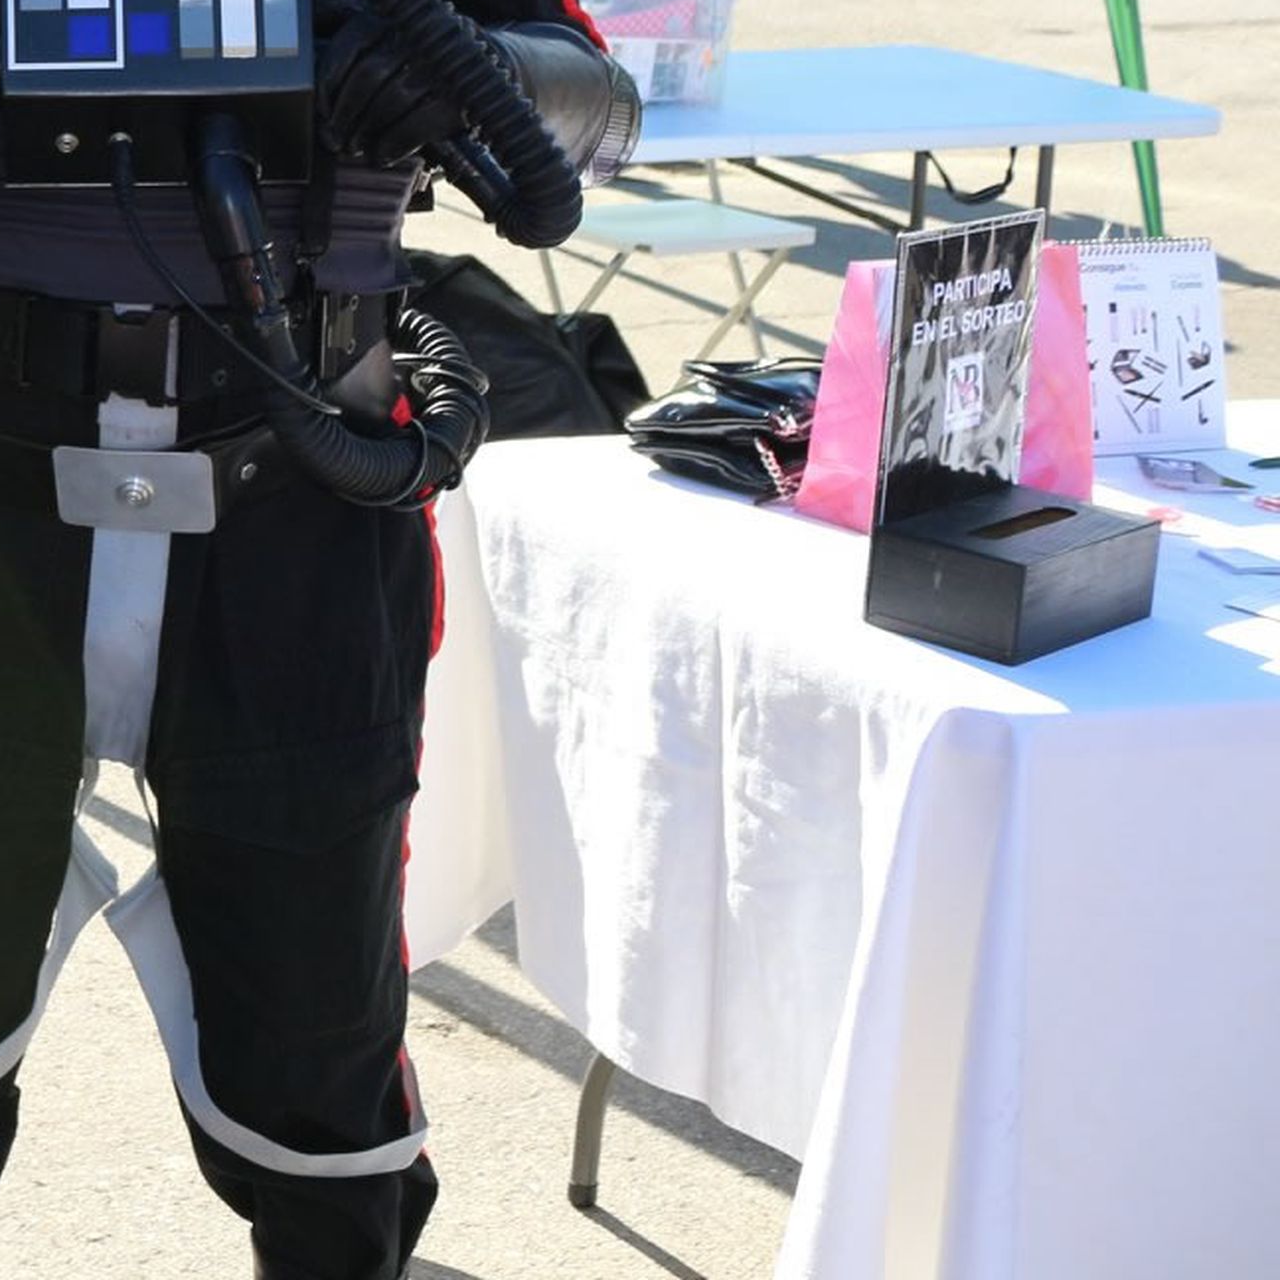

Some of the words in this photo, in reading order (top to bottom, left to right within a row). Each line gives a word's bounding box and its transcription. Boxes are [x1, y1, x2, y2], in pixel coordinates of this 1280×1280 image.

[933, 268, 1013, 307] PARTICIPA
[912, 320, 936, 346] EN
[940, 316, 957, 340] EL
[960, 300, 1026, 334] SORTEO
